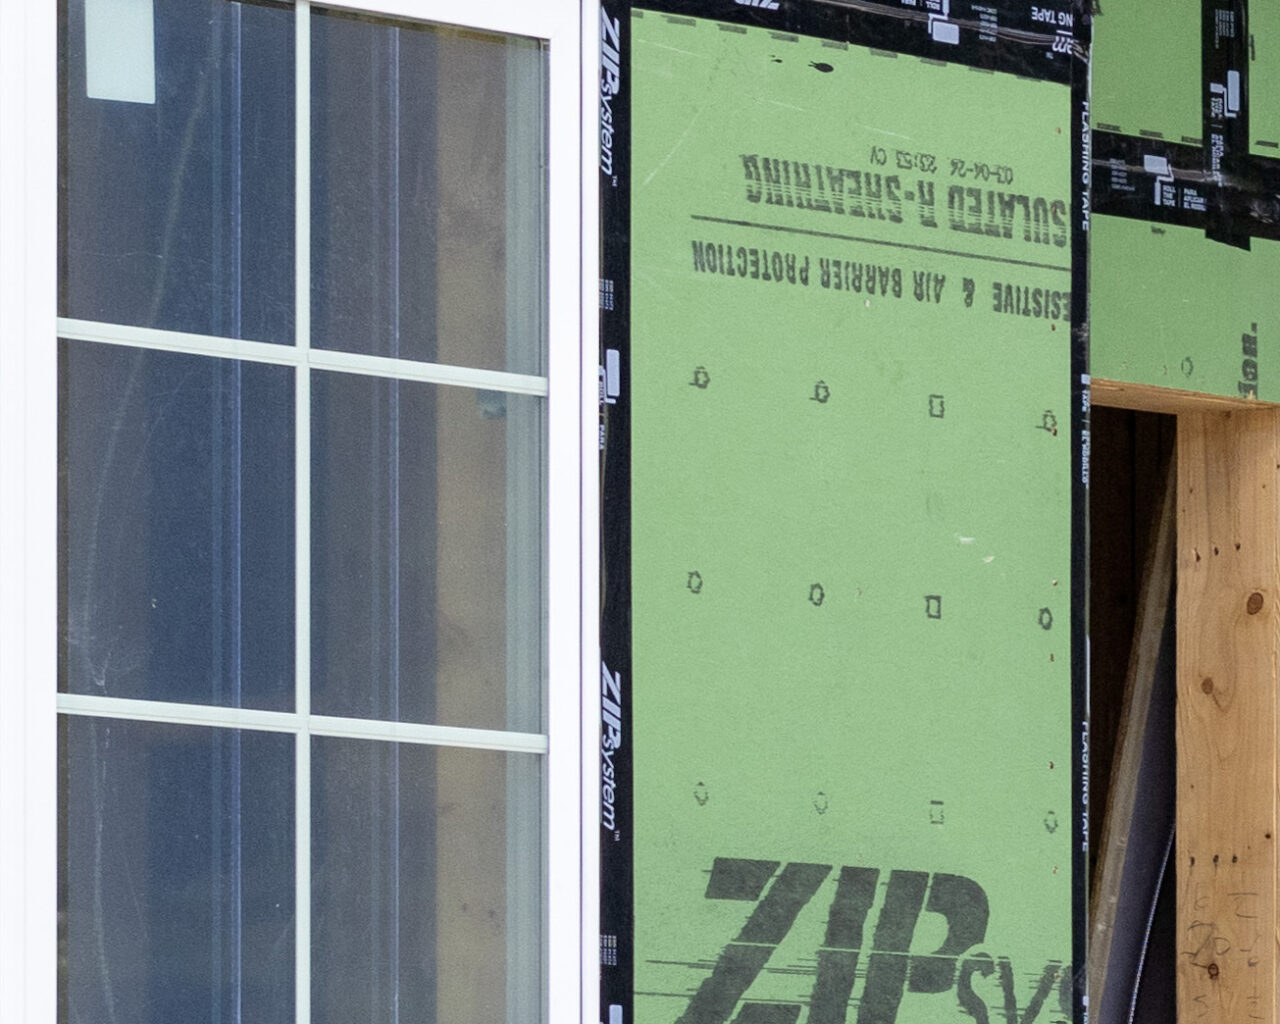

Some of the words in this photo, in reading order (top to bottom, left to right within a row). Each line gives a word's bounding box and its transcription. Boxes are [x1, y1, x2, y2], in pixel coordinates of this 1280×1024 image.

[739, 153, 938, 229] R-SHEATHING
[947, 184, 1068, 249] SULATED
[690, 239, 811, 287] PROTECTION
[820, 257, 903, 299] BARRIER
[913, 270, 946, 304] AIR
[962, 276, 976, 308] &
[992, 281, 1071, 322] ESISTIVE
